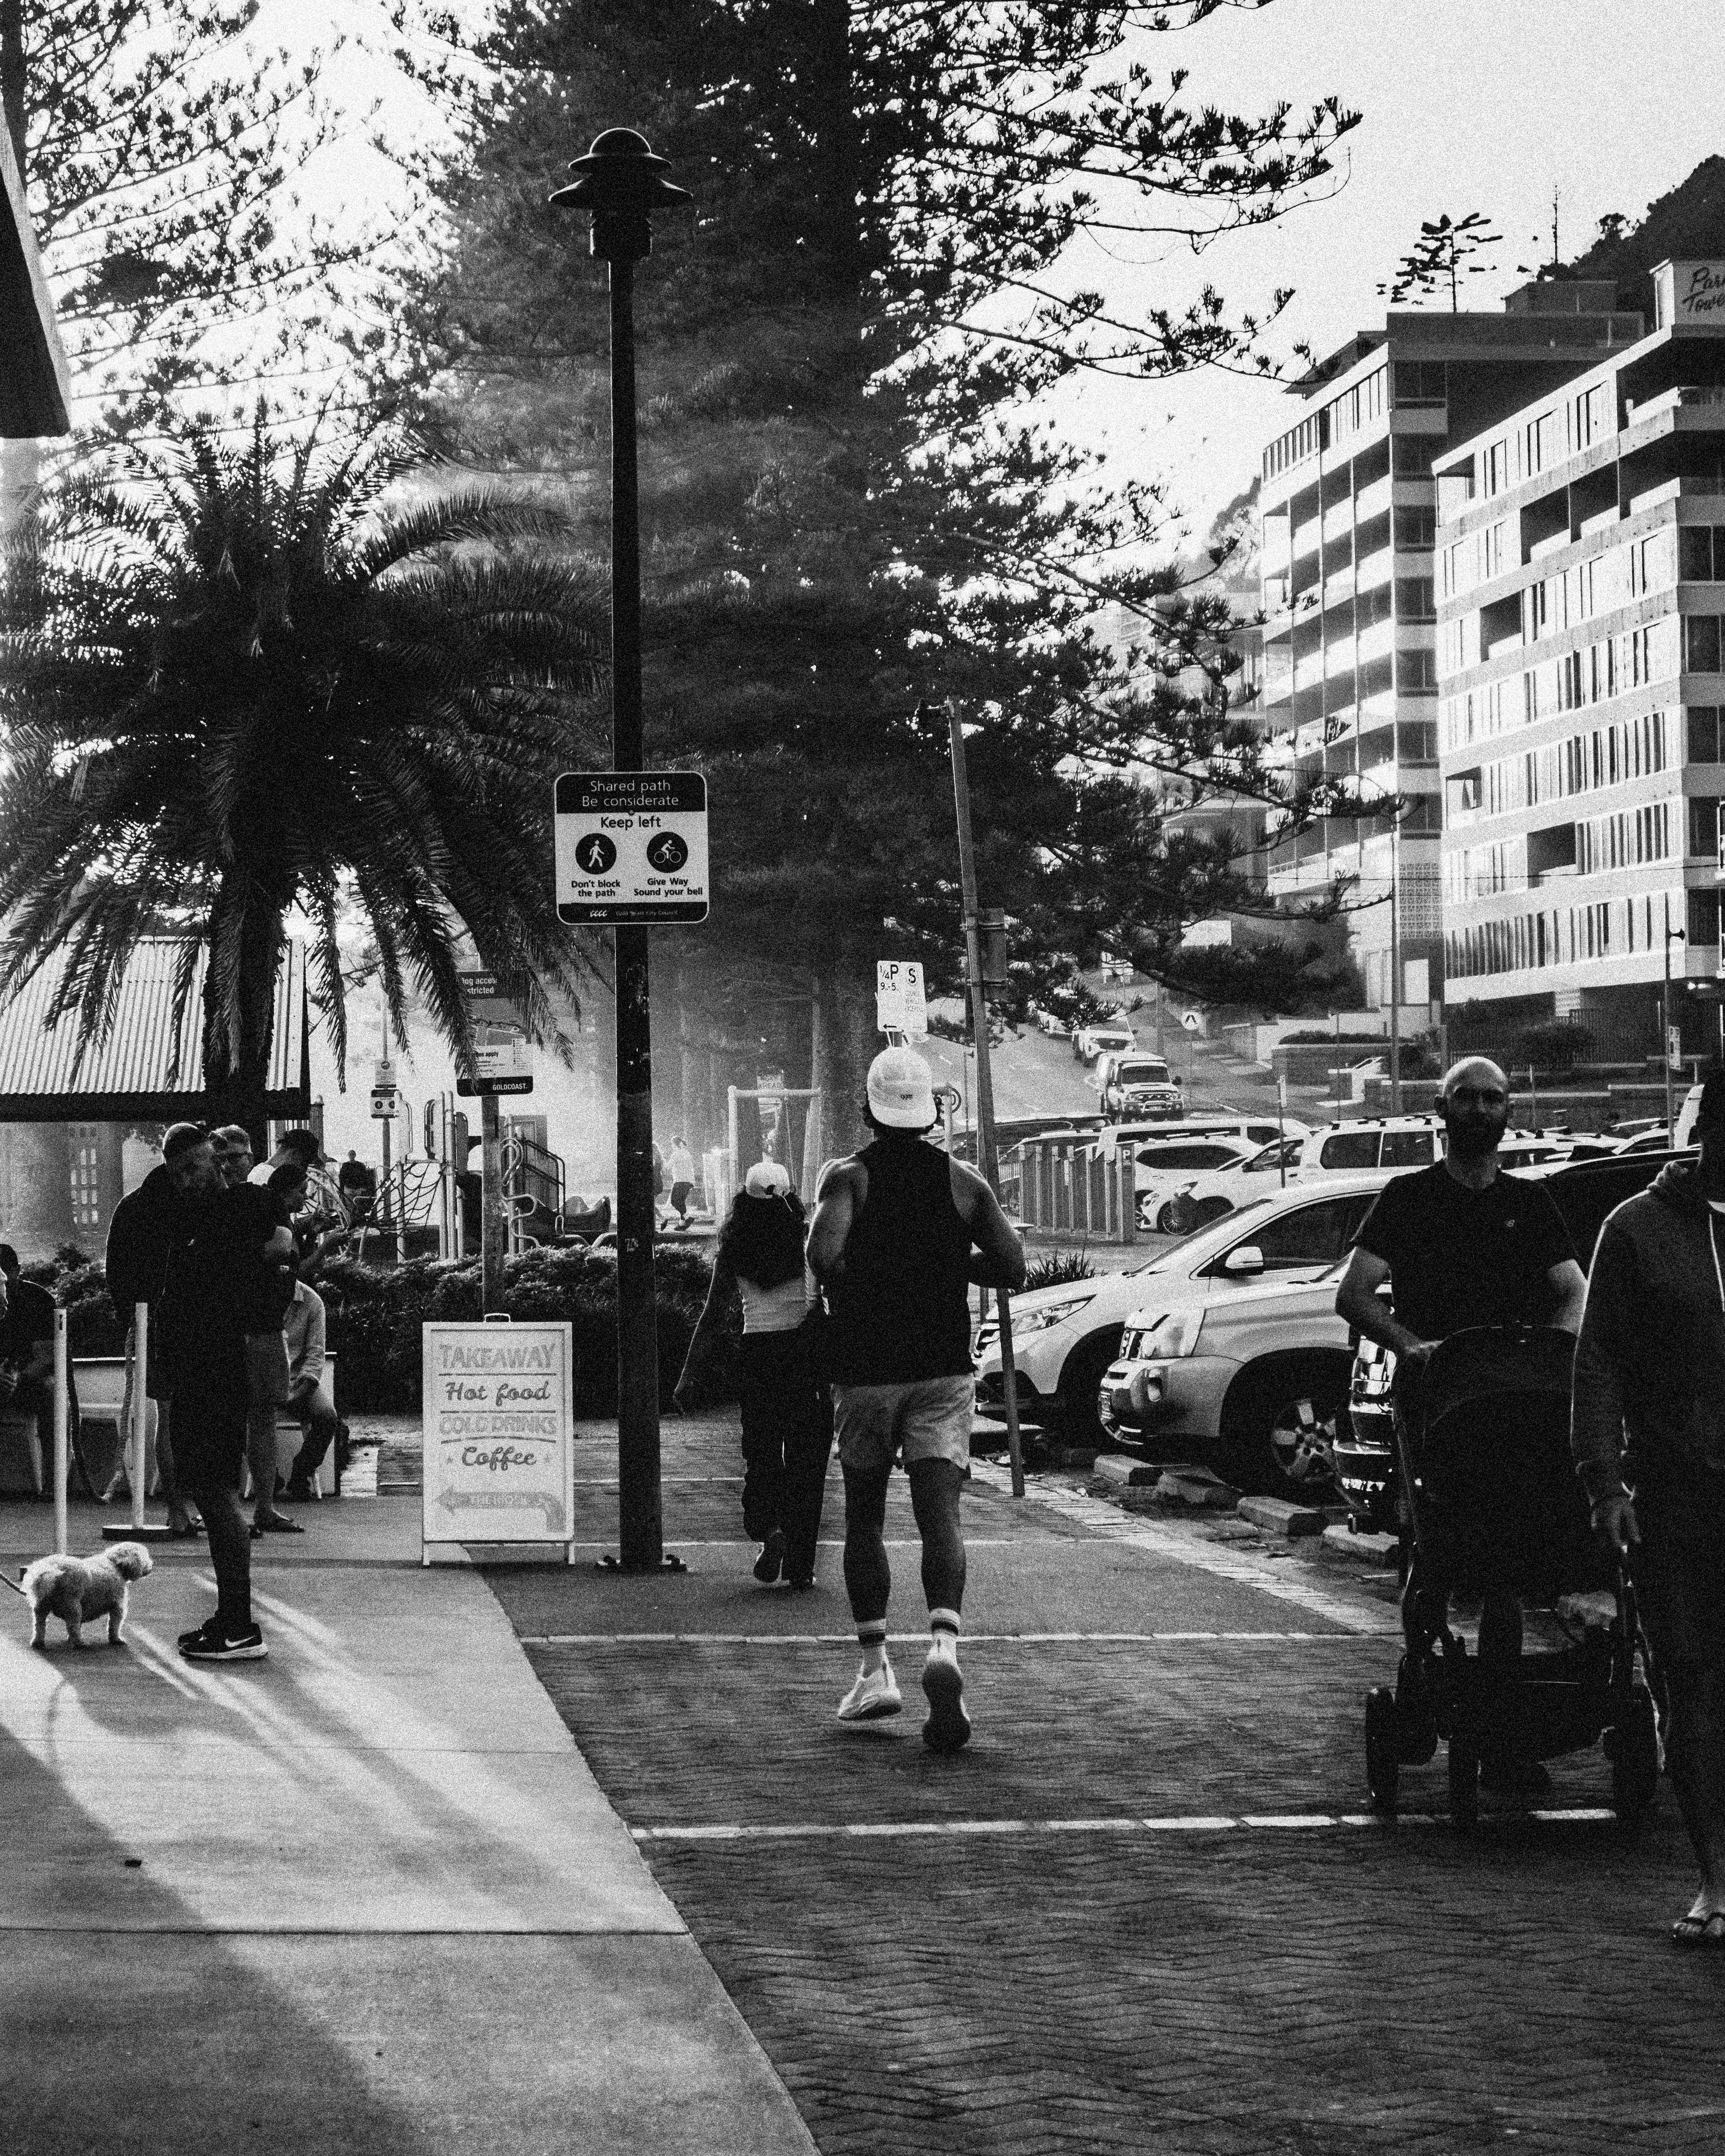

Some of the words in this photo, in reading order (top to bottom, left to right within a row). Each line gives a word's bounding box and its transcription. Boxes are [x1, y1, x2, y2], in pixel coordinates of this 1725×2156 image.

[590, 780, 635, 792] Shared
[641, 779, 671, 793] path
[582, 796, 598, 807] Be
[603, 794, 679, 807] considerate
[600, 816, 633, 831] Keep
[638, 815, 661, 828] left
[598, 880, 621, 888] block
[670, 878, 689, 887] Way
[596, 888, 616, 898] path
[634, 888, 661, 896] Sound
[664, 889, 684, 897] your
[687, 887, 703, 896] bell
[439, 1343, 555, 1368] TAKEAWAY
[445, 1381, 488, 1401] Hot
[496, 1380, 551, 1407] food
[439, 1415, 489, 1435] COLD
[491, 1415, 557, 1435] DRINKS
[461, 1446, 537, 1471] Coffee
